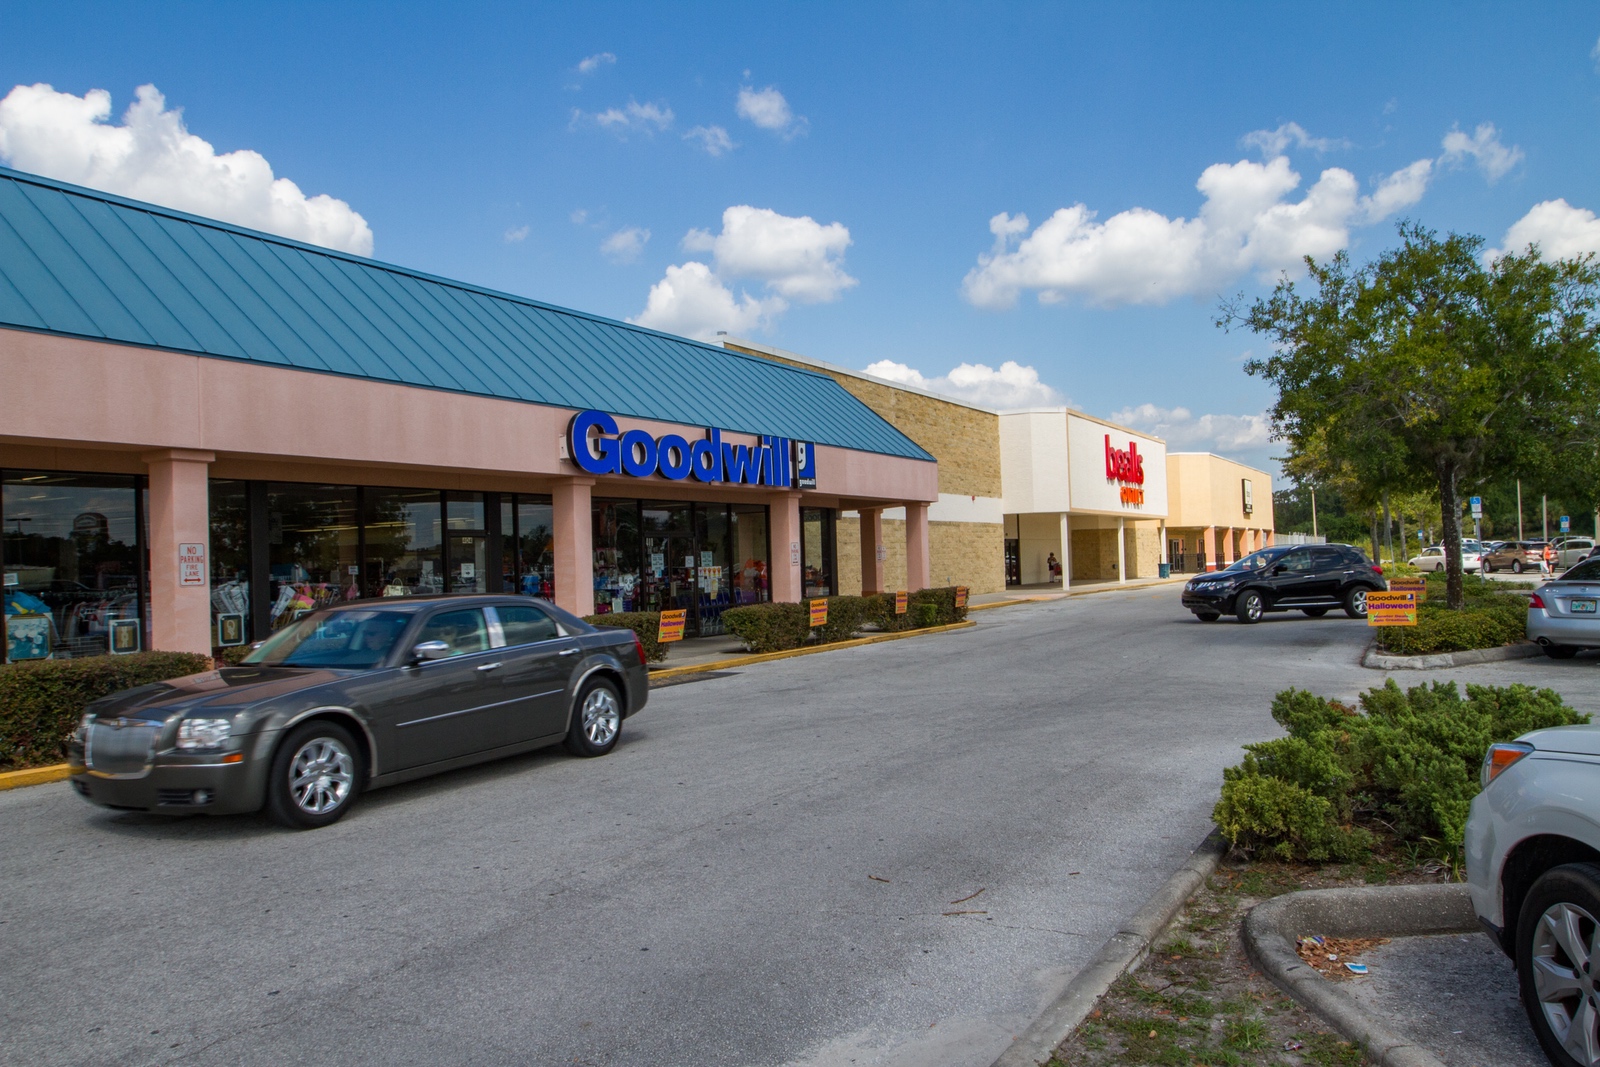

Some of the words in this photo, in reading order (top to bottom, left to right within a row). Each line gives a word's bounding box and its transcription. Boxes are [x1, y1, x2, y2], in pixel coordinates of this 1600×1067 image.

[567, 409, 791, 487] Goodwill
[187, 546, 196, 554] NO
[661, 612, 682, 620] Goodwill
